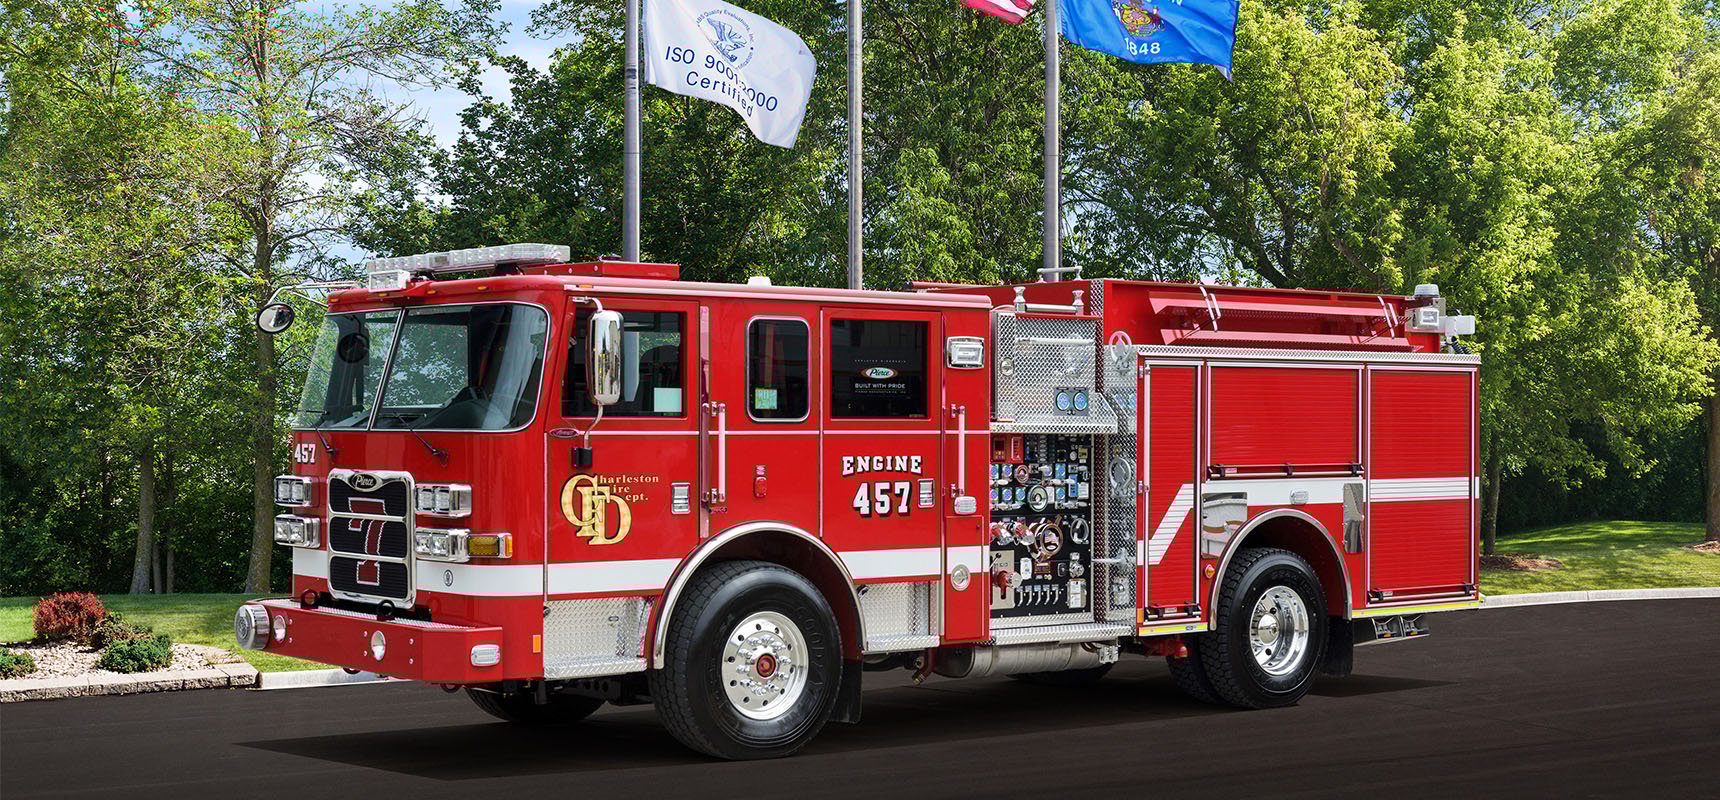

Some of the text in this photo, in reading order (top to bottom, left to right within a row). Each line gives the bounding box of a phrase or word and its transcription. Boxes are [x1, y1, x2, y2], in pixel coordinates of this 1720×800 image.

[665, 46, 695, 65] ISO
[1124, 37, 1161, 56] 1848
[686, 71, 754, 118] Certified
[294, 443, 316, 463] 457
[842, 456, 922, 476] ENGINE
[354, 474, 375, 489] Pierce
[853, 481, 912, 517] 457
[348, 498, 387, 586] 7
